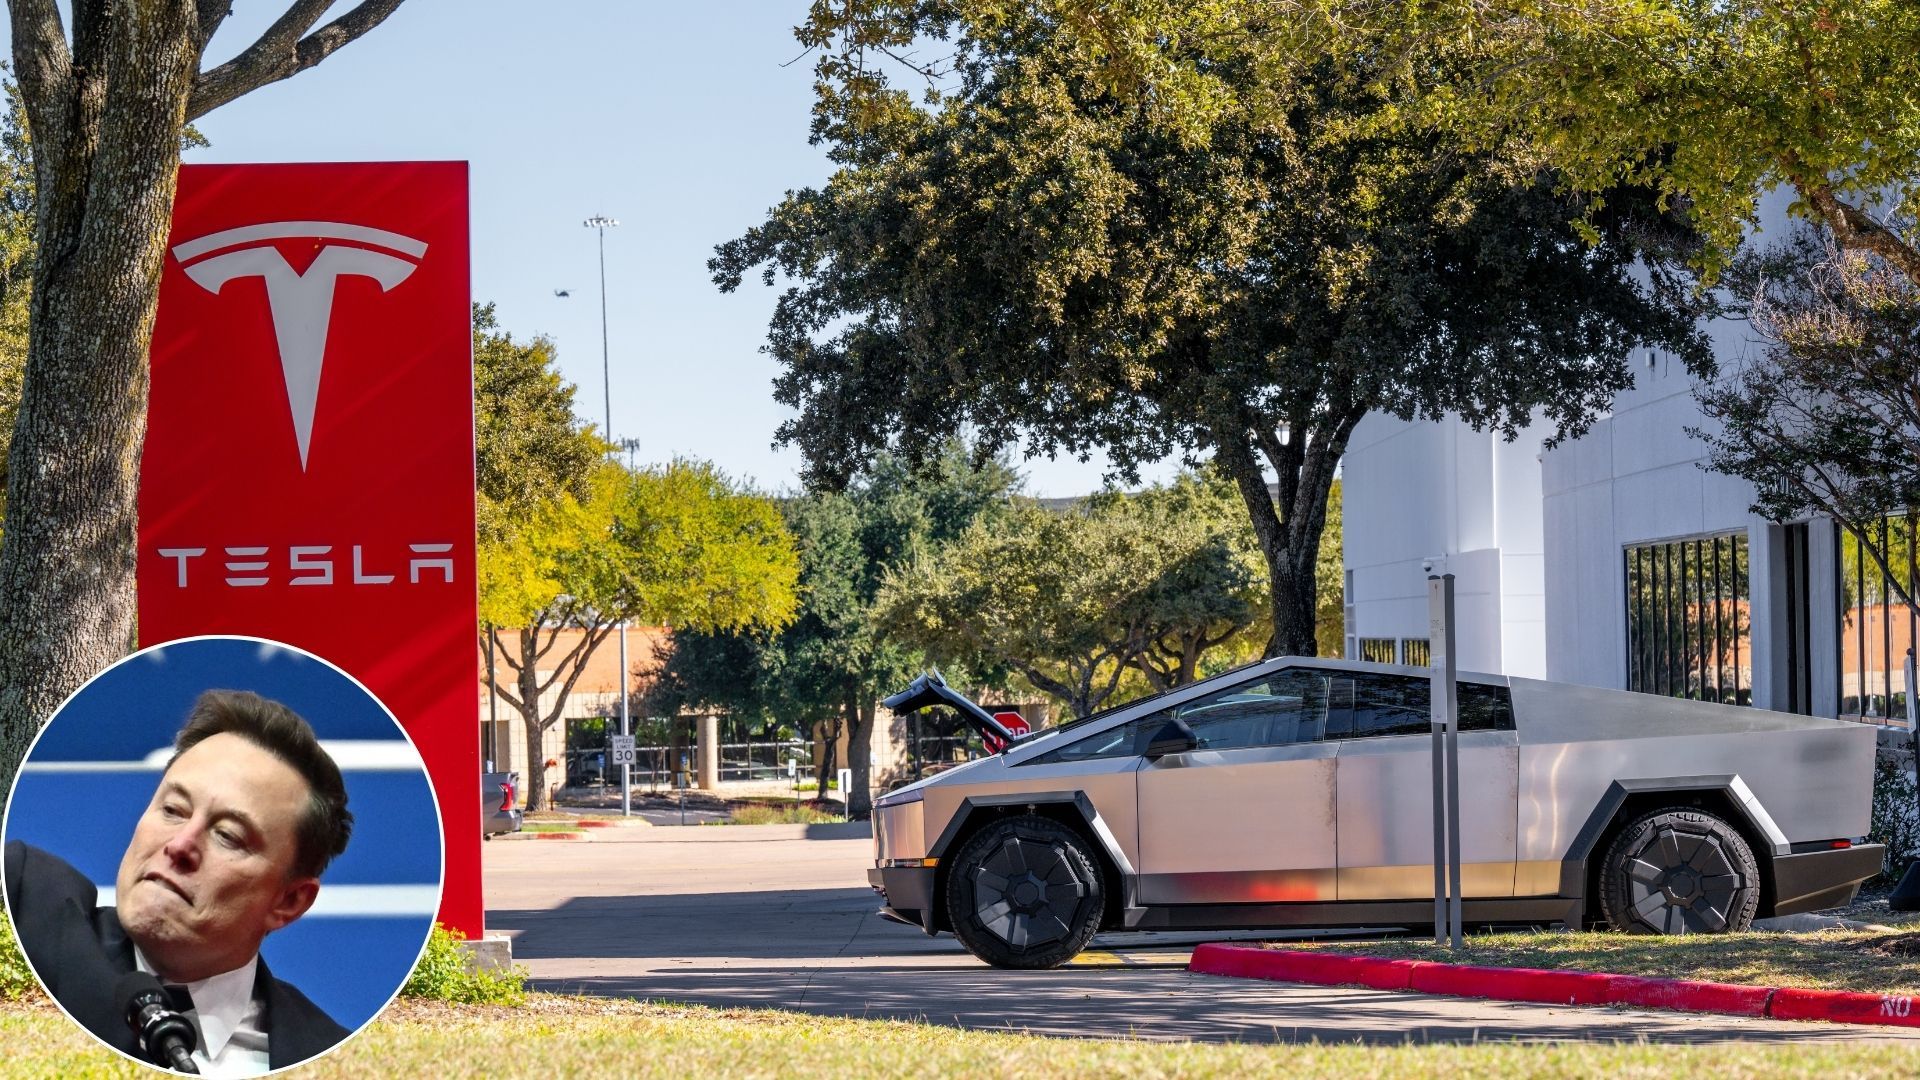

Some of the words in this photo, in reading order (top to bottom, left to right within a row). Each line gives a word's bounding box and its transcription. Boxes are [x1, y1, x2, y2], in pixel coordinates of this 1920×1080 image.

[157, 544, 454, 588] TESLA
[615, 750, 633, 761] 30
[1880, 995, 1912, 1018] NO
